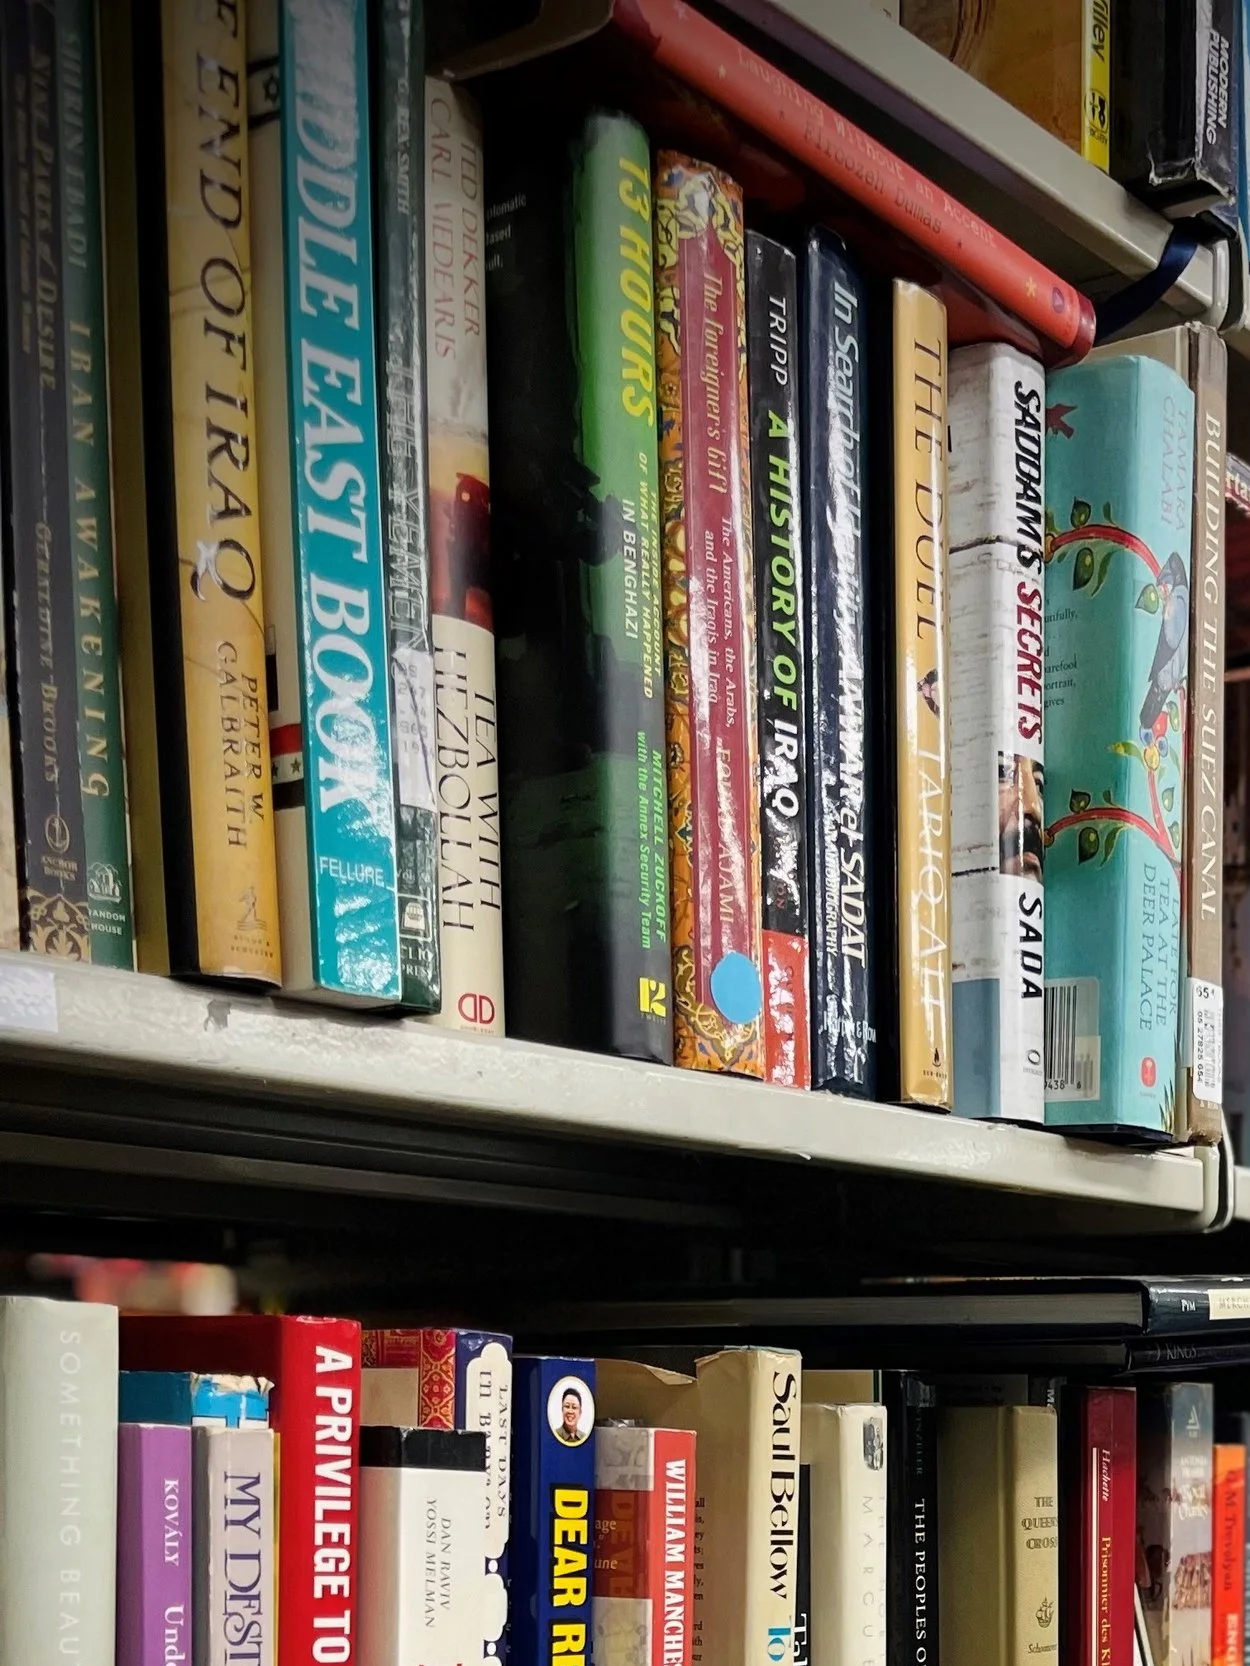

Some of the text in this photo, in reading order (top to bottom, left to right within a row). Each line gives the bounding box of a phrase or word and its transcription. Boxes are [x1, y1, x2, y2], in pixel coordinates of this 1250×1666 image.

[197, 53, 241, 230] END
[430, 98, 454, 182] CARL
[1205, 28, 1220, 145] PUBLISHING
[1217, 36, 1230, 128] MODERN
[200, 257, 247, 371] OF
[459, 142, 482, 336] TED DEKKER
[618, 158, 655, 427] 13 HOURS
[68, 320, 109, 798] IRAN AWAKENING
[191, 384, 256, 601] IRAQ
[300, 339, 377, 813] EAST BOOK
[623, 500, 638, 639] IN BENGHAZI
[767, 295, 800, 818] TRIPP A HISTORY OF IRAQ
[913, 338, 945, 641] THE DUEL
[640, 481, 653, 699] WHAT REALLY HAPPENED
[1199, 413, 1222, 921] BUILDING THE SUEZ CANAL
[216, 641, 247, 848] GALBRAITH
[240, 675, 262, 781] PETER
[1013, 380, 1044, 1001] SADDAM'S SECRETS SADA
[433, 648, 475, 931] HEZBOLLAH
[473, 691, 501, 911] TEA WITH
[637, 732, 652, 948] with the Annex Security Team
[652, 750, 666, 943] MITCHELL ZUCKOFF
[1139, 863, 1156, 1031] DEER PALACE
[59, 1330, 81, 1548] SOMETHING
[315, 1345, 352, 1375] A
[163, 1479, 182, 1566] KOVÁLY
[223, 1472, 261, 1542] MY
[312, 1386, 350, 1599] PRIVILEGE
[425, 1499, 437, 1628] YOSSI MELMAN
[439, 1518, 451, 1610] DAN RAVIV
[550, 1486, 589, 1608] DEAR
[665, 1459, 686, 1562] WILLIAM
[768, 1371, 798, 1600] Saul Bellow
[914, 1498, 927, 1543] THE
[312, 1609, 351, 1663] TO
[914, 1546, 928, 1642] PEOPLES
[1100, 1537, 1111, 1613] Prisonnier
